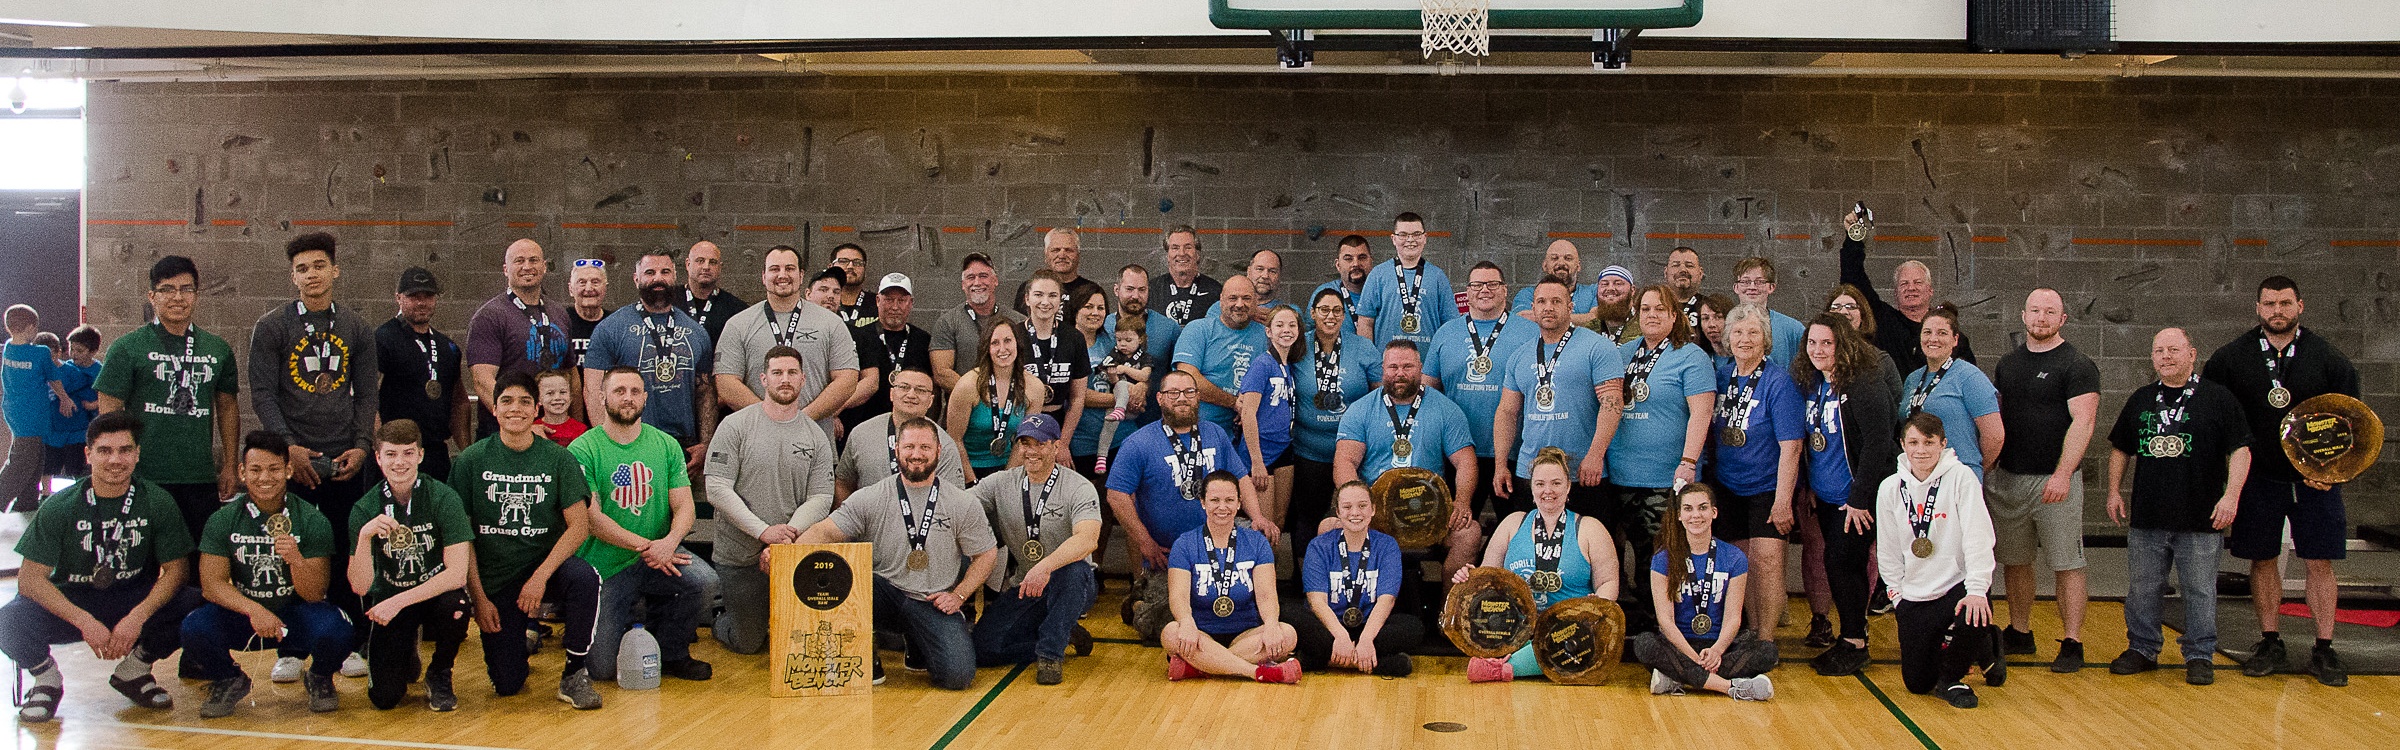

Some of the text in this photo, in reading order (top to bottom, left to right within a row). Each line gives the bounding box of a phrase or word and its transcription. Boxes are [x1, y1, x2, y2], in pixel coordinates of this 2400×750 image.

[629, 324, 692, 340] Wisey
[787, 313, 800, 333] 2019
[1556, 331, 1571, 353] 2019
[482, 471, 552, 483] Grandma's
[1044, 467, 1060, 493] 2019
[1923, 495, 1935, 522] 2019
[479, 524, 518, 536] House
[919, 509, 933, 536] 2019
[1509, 558, 1536, 571] GORILL
[276, 584, 295, 596] Gy
[1700, 581, 1711, 608] 2019
